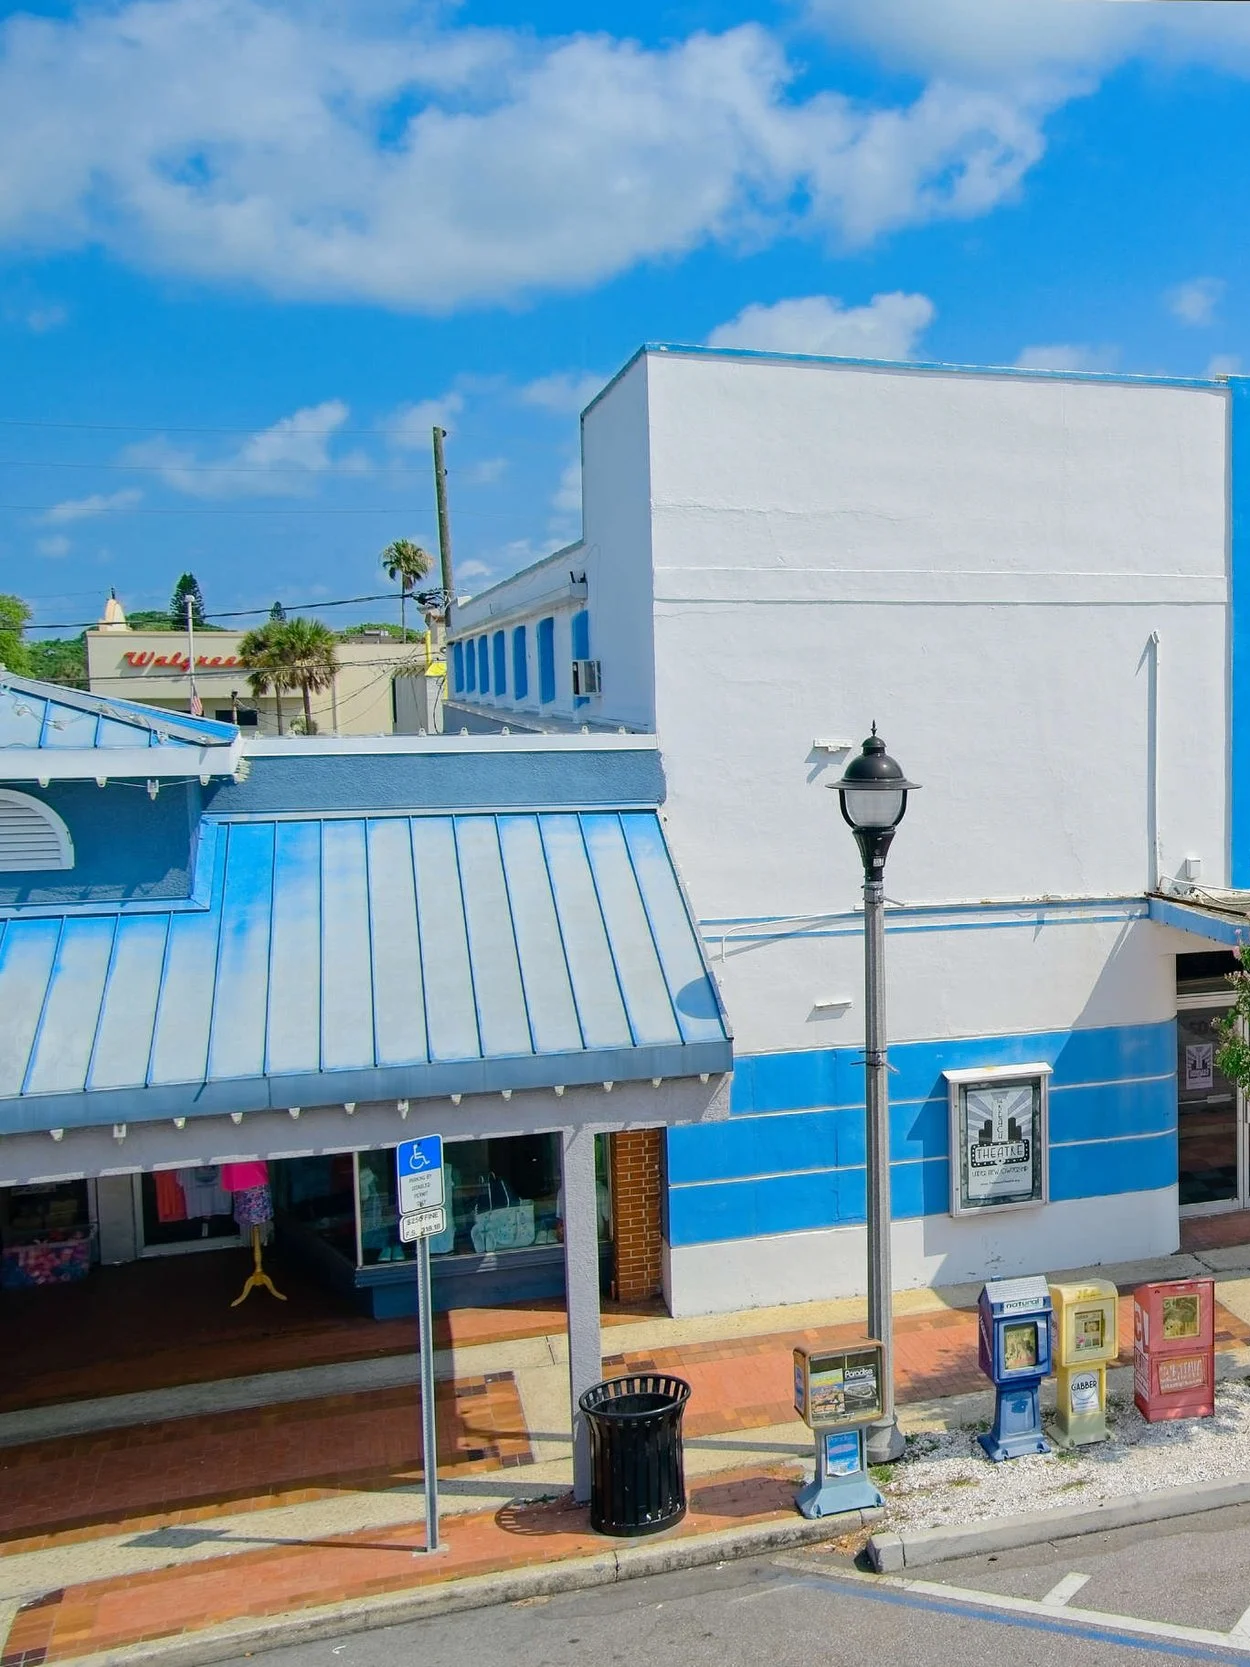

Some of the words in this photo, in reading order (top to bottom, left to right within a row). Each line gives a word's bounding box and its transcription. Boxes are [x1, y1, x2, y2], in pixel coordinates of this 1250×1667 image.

[124, 651, 246, 672] Walgree
[977, 1145, 1023, 1158] THEATRE
[424, 1213, 438, 1221] FINE
[1006, 1298, 1040, 1309] natural
[845, 1367, 873, 1380] Paradise
[1071, 1380, 1097, 1392] GABBER
